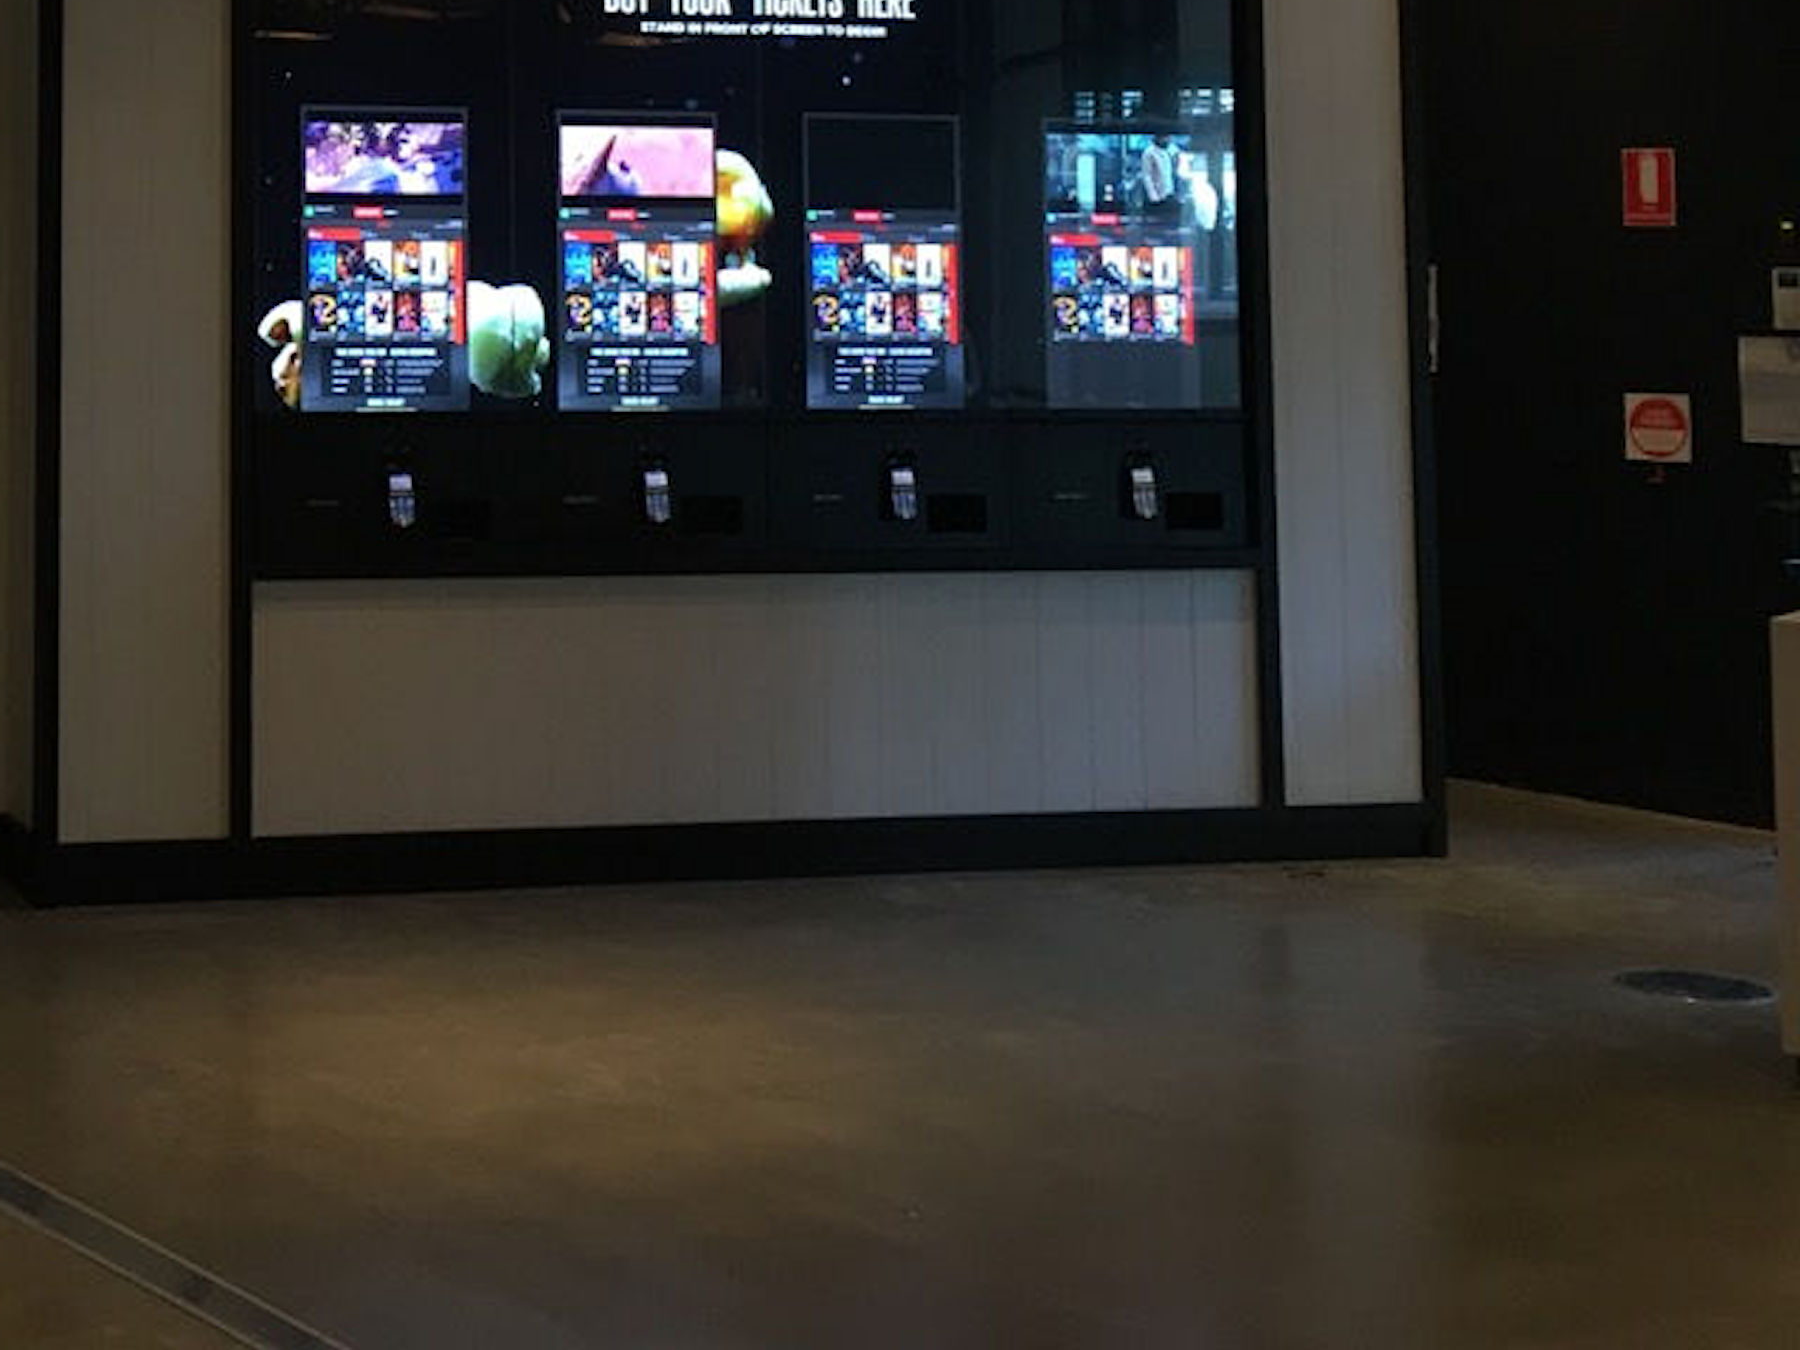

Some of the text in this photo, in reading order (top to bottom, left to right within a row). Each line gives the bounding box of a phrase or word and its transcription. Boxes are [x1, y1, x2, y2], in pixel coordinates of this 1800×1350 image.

[640, 20, 888, 39] STAND IN FRONT OF SCREEN TO BEGIN
